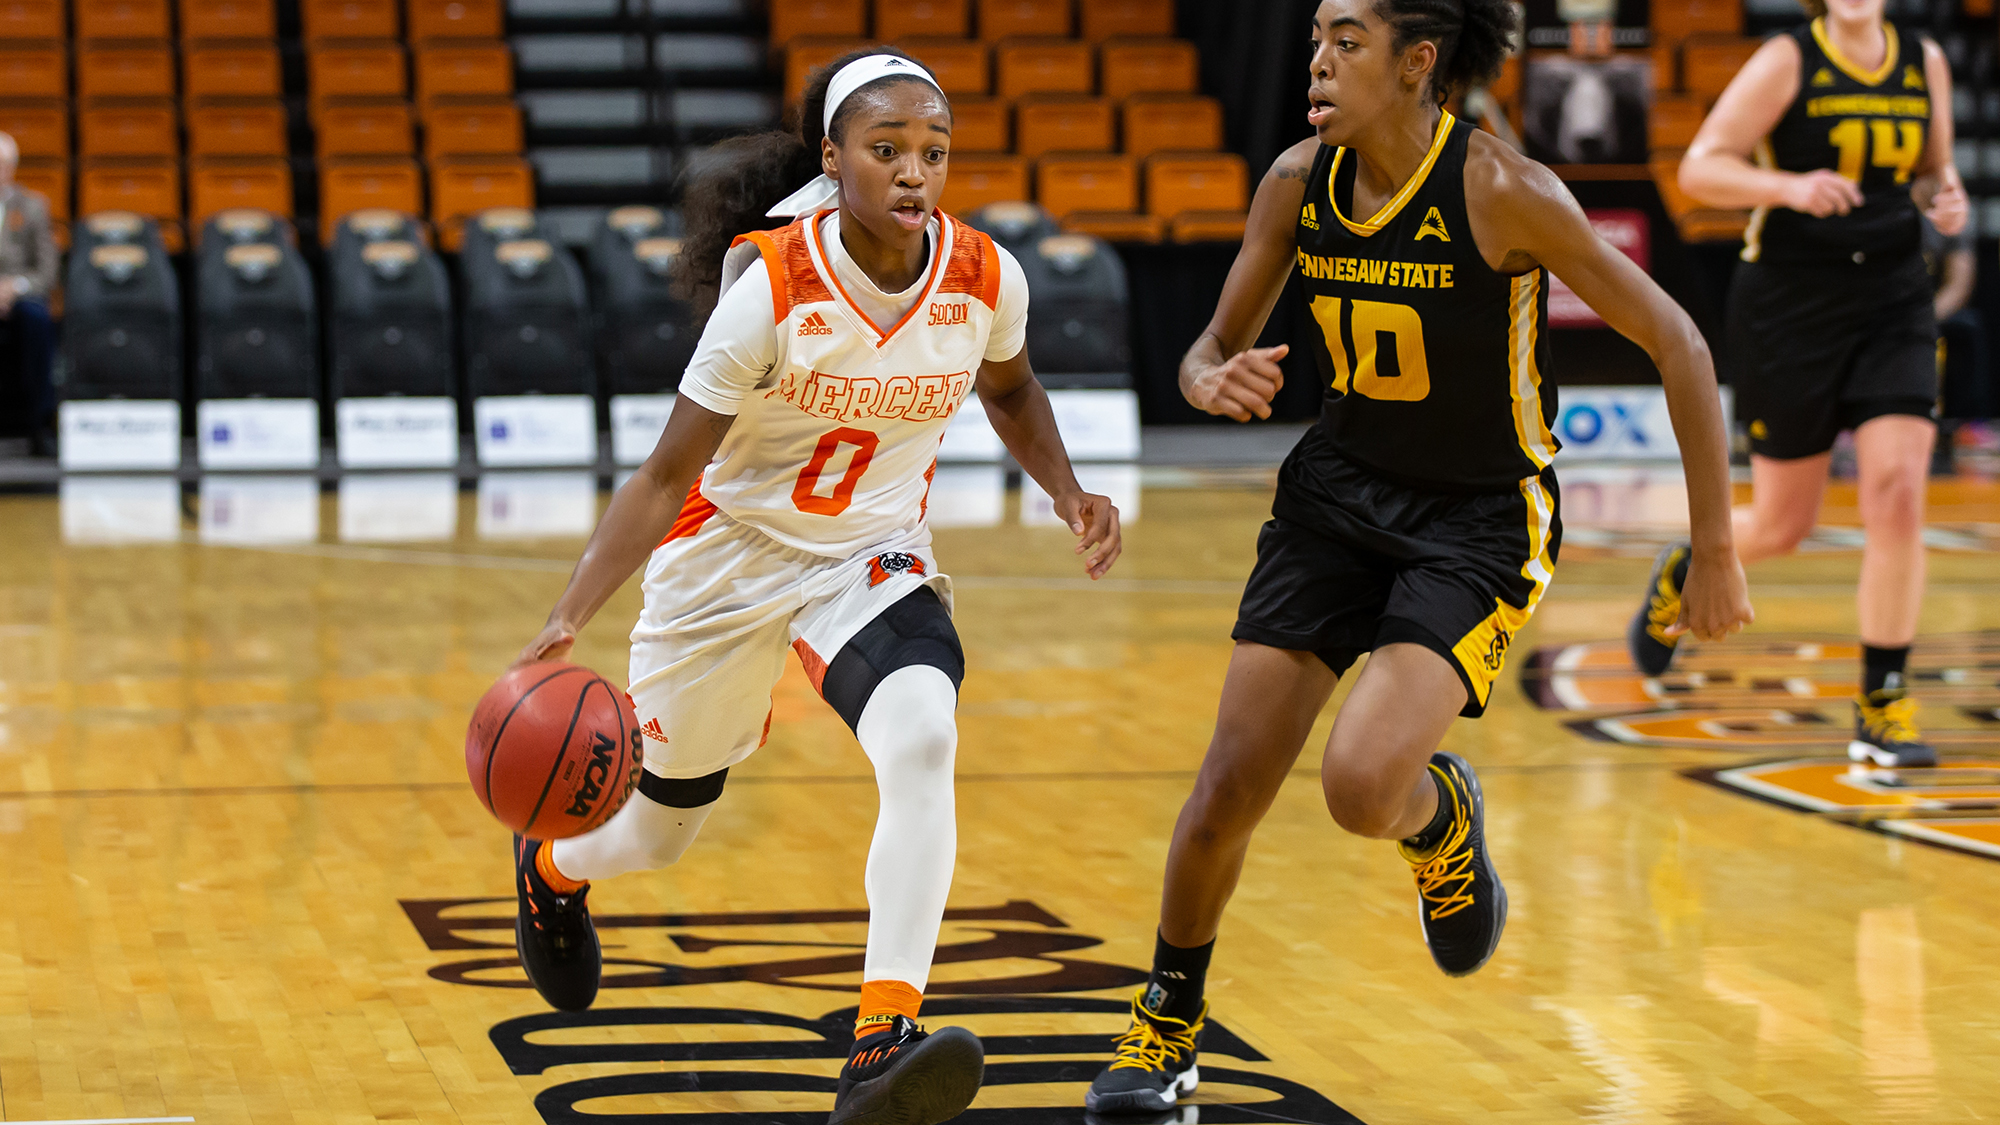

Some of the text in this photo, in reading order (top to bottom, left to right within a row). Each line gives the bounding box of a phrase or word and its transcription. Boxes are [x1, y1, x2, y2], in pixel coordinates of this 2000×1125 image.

[1828, 118, 1923, 185] 14
[1297, 246, 1455, 289] ENNESAW STATE
[797, 324, 833, 337] adidas
[1308, 294, 1431, 402] 10
[763, 369, 971, 424] MERCER
[1562, 402, 1652, 447] OX
[790, 426, 881, 517] 0
[640, 726, 669, 744] adidas
[565, 730, 616, 818] NCAA
